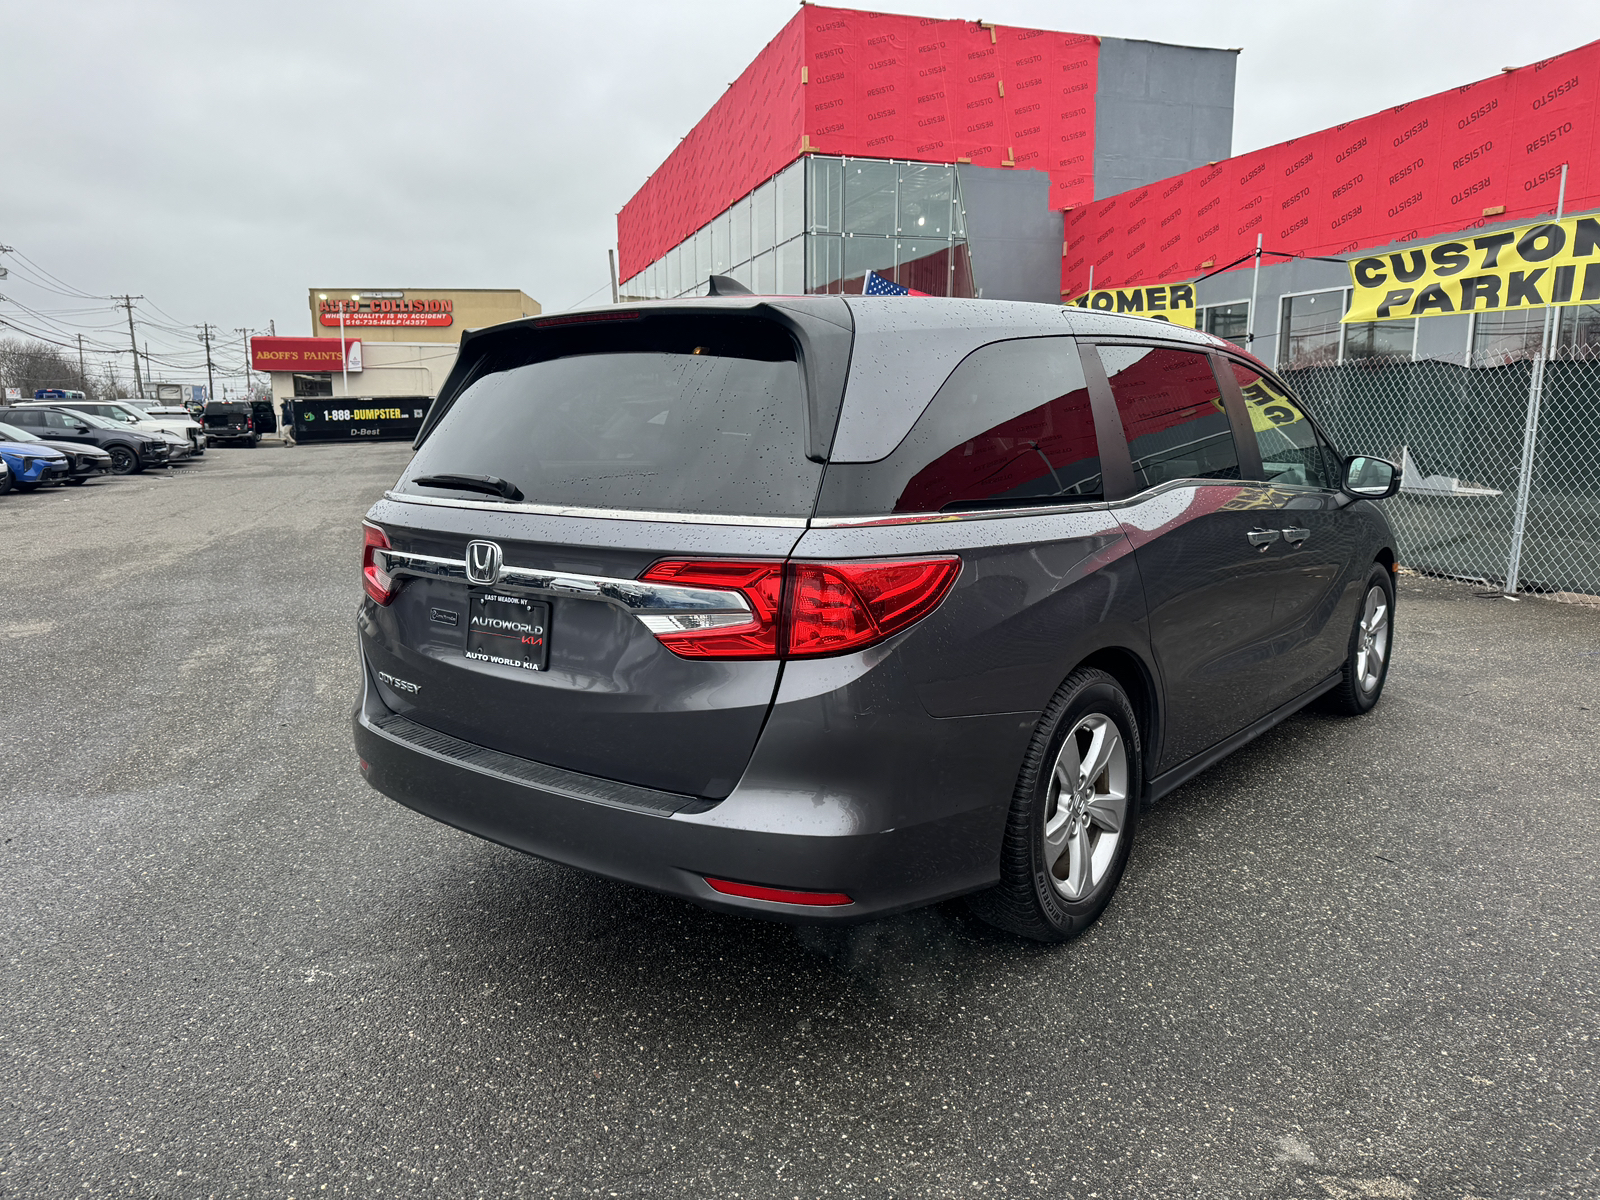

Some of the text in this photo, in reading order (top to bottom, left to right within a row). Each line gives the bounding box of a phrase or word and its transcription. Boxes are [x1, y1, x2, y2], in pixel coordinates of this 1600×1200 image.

[816, 22, 846, 33] RESISTO
[867, 34, 896, 46] RESISTO
[1064, 34, 1091, 47] RESISTO
[815, 48, 844, 60] RESISTO
[918, 42, 946, 53] RESISTO
[967, 48, 995, 60] RESISTO
[868, 59, 897, 71] RESISTO
[1015, 56, 1042, 67] RESISTO
[1062, 60, 1089, 72] RESISTO
[919, 66, 947, 77] RESISTO
[968, 72, 995, 84] RESISTO
[815, 72, 845, 85] RESISTO
[1016, 79, 1043, 90] RESISTO
[867, 85, 895, 97] RESISTO
[1063, 84, 1089, 95] RESISTO
[1532, 76, 1579, 111] RESISTO
[917, 92, 945, 104] RESISTO
[966, 97, 994, 109] RESISTO
[814, 99, 844, 112] RESISTO
[1014, 104, 1041, 116] RESISTO
[867, 110, 896, 122] RESISTO
[1061, 108, 1087, 120] RESISTO
[1457, 99, 1499, 131] RESISTO
[917, 116, 946, 128] RESISTO
[967, 122, 994, 133] RESISTO
[815, 124, 845, 137] RESISTO
[1014, 128, 1041, 139] RESISTO
[1393, 119, 1429, 148] RESISTO
[866, 136, 895, 148] RESISTO
[1061, 132, 1087, 143] RESISTO
[1525, 122, 1573, 155] RESISTO
[916, 141, 944, 154] RESISTO
[965, 146, 993, 158] RESISTO
[1335, 137, 1368, 164] RESISTO
[1059, 156, 1085, 167] RESISTO
[1452, 141, 1493, 171] RESISTO
[1285, 153, 1314, 177] RESISTO
[1199, 165, 1224, 188] RESISTO
[1240, 164, 1266, 186] RESISTO
[1388, 158, 1425, 187] RESISTO
[1059, 178, 1085, 190] RESISTO
[1163, 180, 1184, 200] RESISTO
[1331, 174, 1365, 200] RESISTO
[1450, 177, 1491, 206] RESISTO
[1281, 187, 1311, 211] RESISTO
[1387, 192, 1423, 219] RESISTO
[1197, 197, 1221, 217] RESISTO
[1160, 208, 1182, 228] RESISTO
[1331, 205, 1363, 230] RESISTO
[1237, 215, 1263, 236] RESISTO
[1280, 217, 1309, 239] RESISTO
[1197, 224, 1220, 244] RESISTO
[1160, 234, 1181, 253] RESISTO
[1157, 262, 1179, 280] RESISTO
[319, 299, 453, 313] AUTO COLLISION
[256, 351, 343, 361] ABOFF'S PAINTS
[350, 428, 380, 436] D-Best
[471, 615, 544, 635] AUTOWORLD
[521, 635, 543, 646] KIA
[465, 651, 539, 671] AUTO WORLD KIA
[378, 671, 422, 695] ODYSSEY
[1037, 874, 1061, 922] MICHELIN
